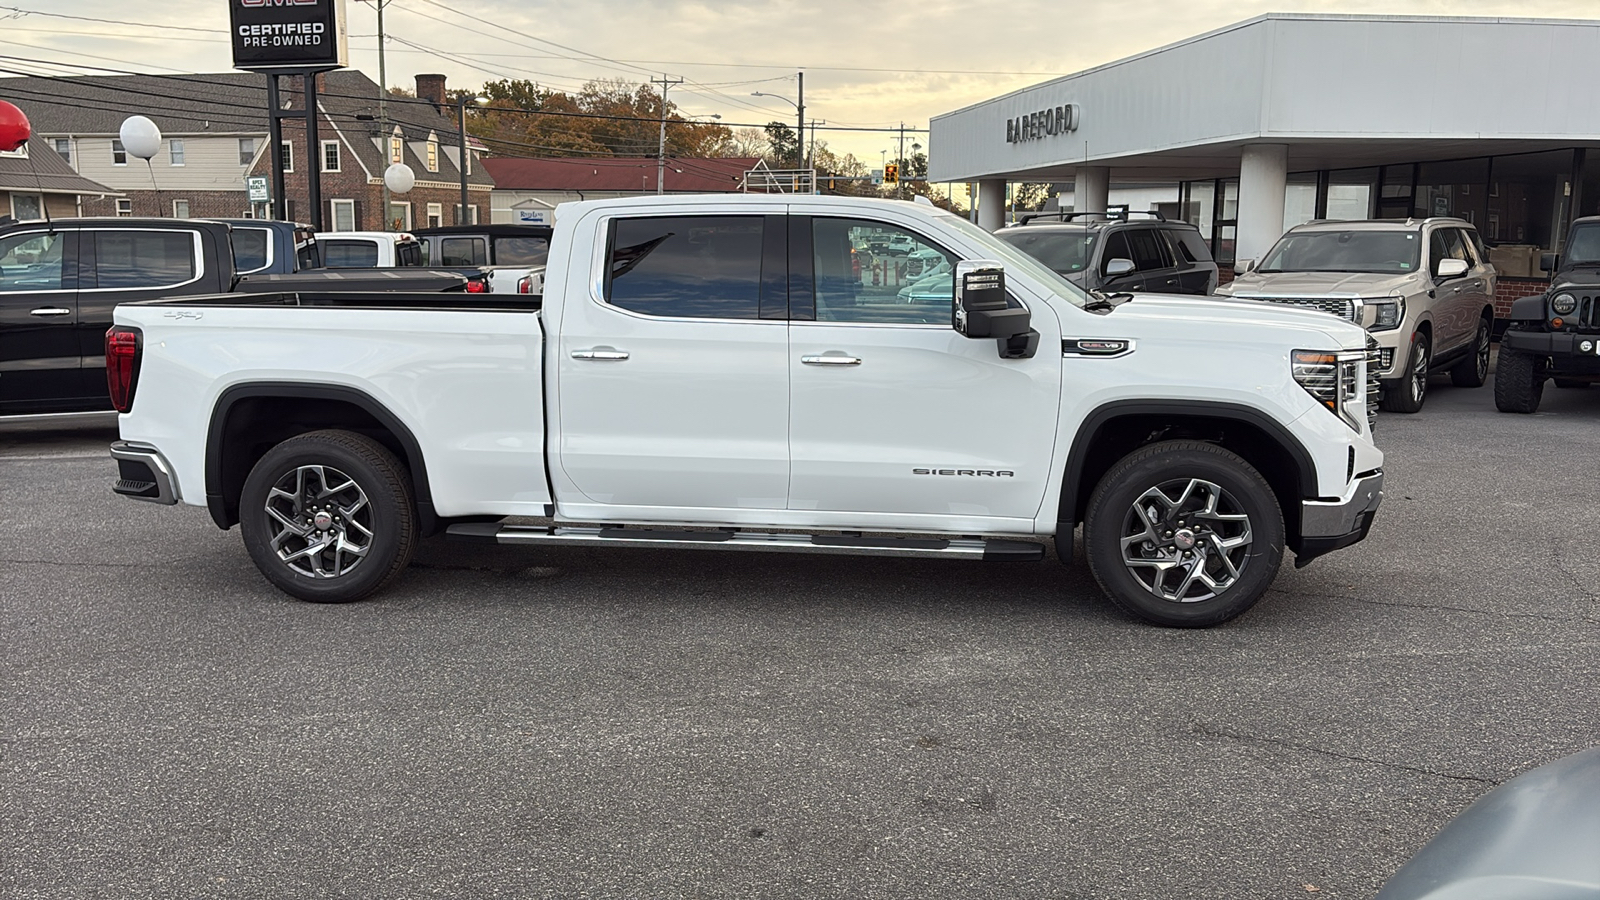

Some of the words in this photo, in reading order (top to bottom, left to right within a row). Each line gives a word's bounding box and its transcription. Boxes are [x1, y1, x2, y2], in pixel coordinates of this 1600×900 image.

[239, 22, 325, 36] CERTIFIED
[244, 35, 321, 47] PRE-OWNED
[1006, 103, 1079, 144] BAREFORD
[912, 468, 1014, 478] SIERRA
